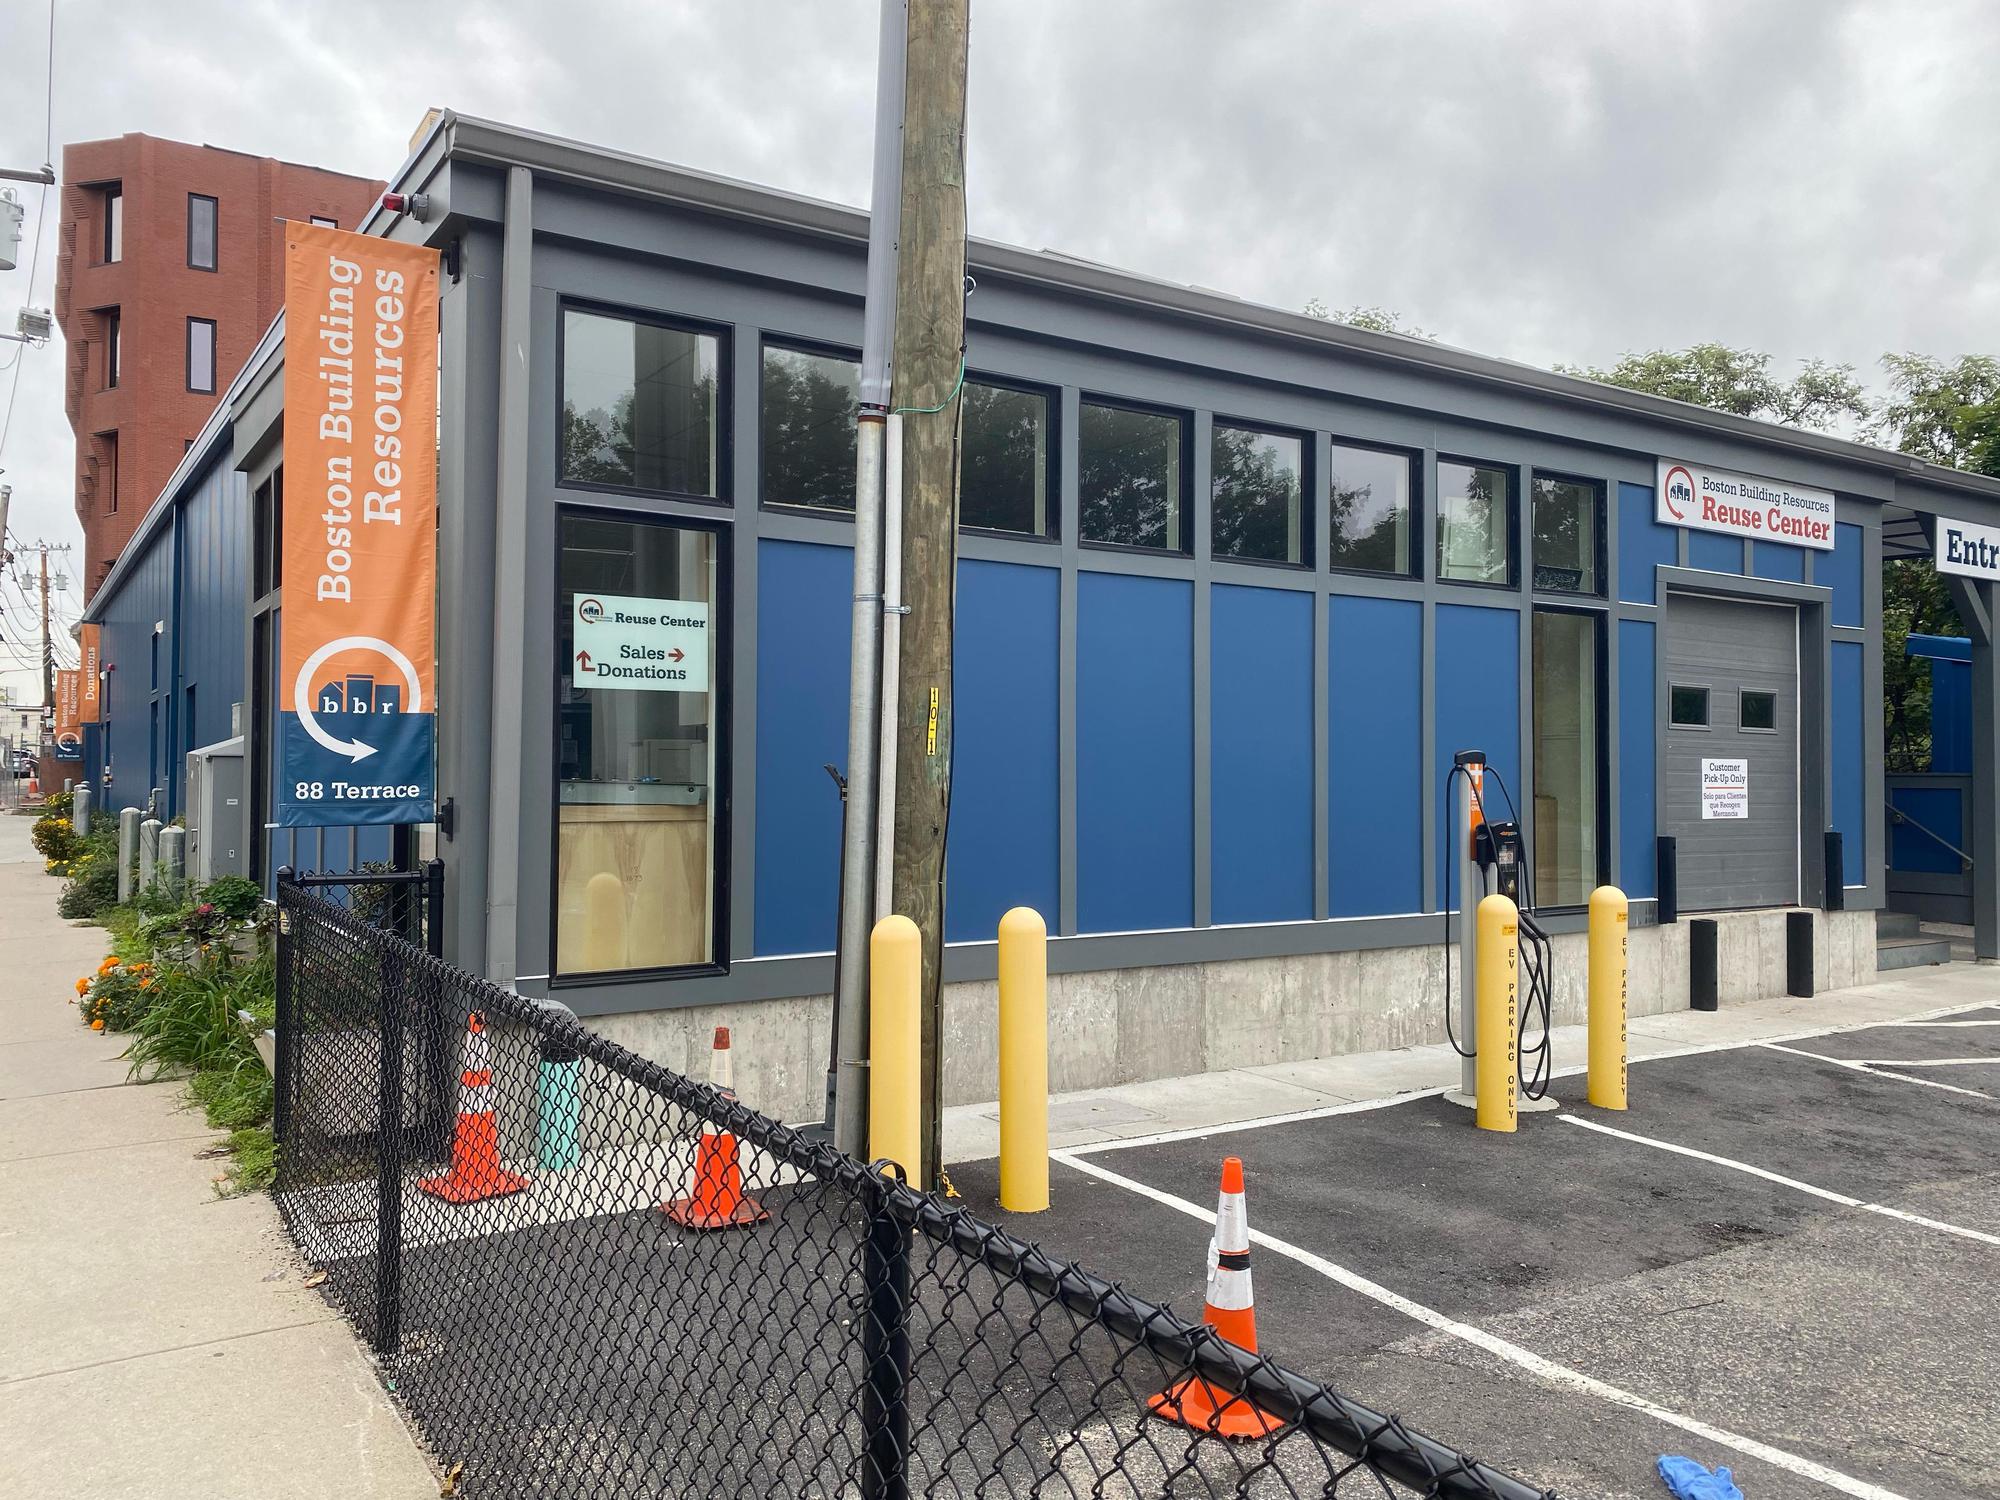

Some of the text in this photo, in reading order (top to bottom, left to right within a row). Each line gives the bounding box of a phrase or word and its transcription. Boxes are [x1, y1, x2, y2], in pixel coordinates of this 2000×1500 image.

[364, 269, 405, 526] Resources
[317, 255, 363, 603] Boston Building
[1702, 476, 1830, 513] Boston Building Resources
[1702, 495, 1830, 541] Reuse Center
[1946, 528, 2000, 570] Entr
[615, 612, 656, 625] Reuse
[660, 615, 706, 628] Center
[620, 644, 665, 660] Sales
[85, 646, 95, 701] Donations
[597, 662, 686, 680] Donations
[61, 674, 69, 703] Building
[69, 674, 77, 715] Resources
[1704, 774, 1746, 784] Pick-Up Only
[1709, 762, 1740, 771] Customer
[295, 782, 420, 799] 88 Terrace
[1508, 948, 1514, 969] EV
[1622, 937, 1627, 957] EV
[1507, 1075, 1515, 1120] ONLY
